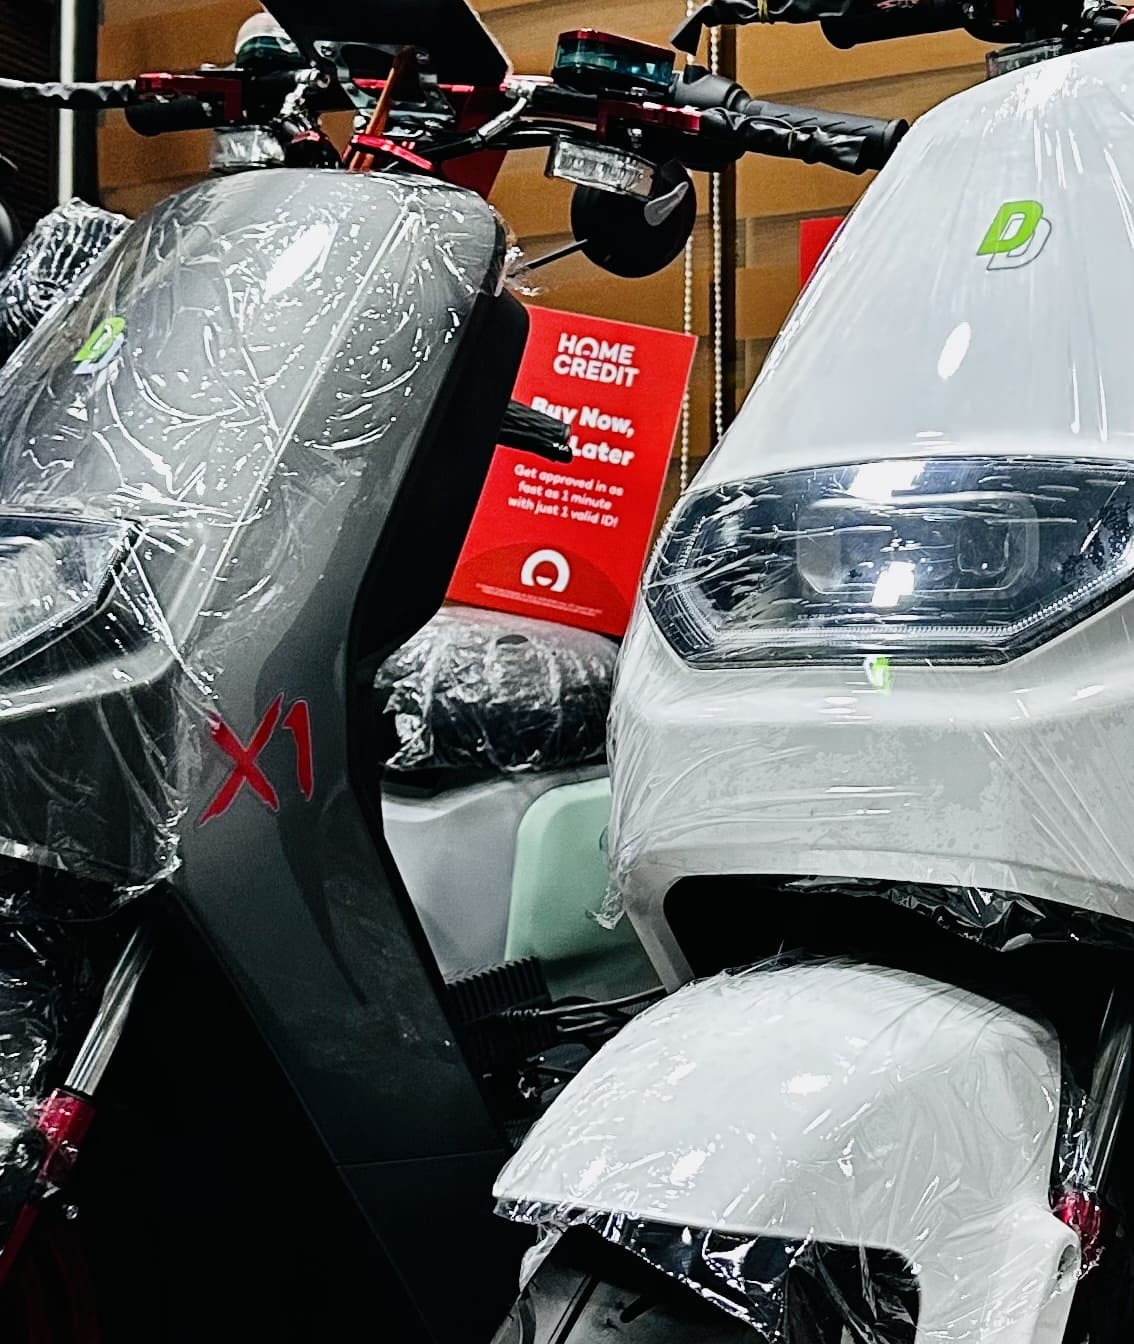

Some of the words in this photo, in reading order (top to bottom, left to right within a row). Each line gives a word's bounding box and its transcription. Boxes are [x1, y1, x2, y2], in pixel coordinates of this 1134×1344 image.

[557, 332, 636, 366] HOME
[553, 354, 640, 388] CREDIT
[579, 405, 636, 439] Now,
[569, 435, 635, 467] Later
[514, 463, 538, 479] Get
[538, 471, 595, 491] approved
[595, 479, 607, 493] in
[608, 485, 624, 497] as
[518, 480, 543, 496] fast
[544, 488, 560, 499] as
[570, 493, 613, 510] minute
[508, 496, 535, 511] with
[533, 500, 559, 516] just
[570, 509, 600, 524] valid
[600, 513, 619, 528] ID!
[198, 691, 314, 829] X1
